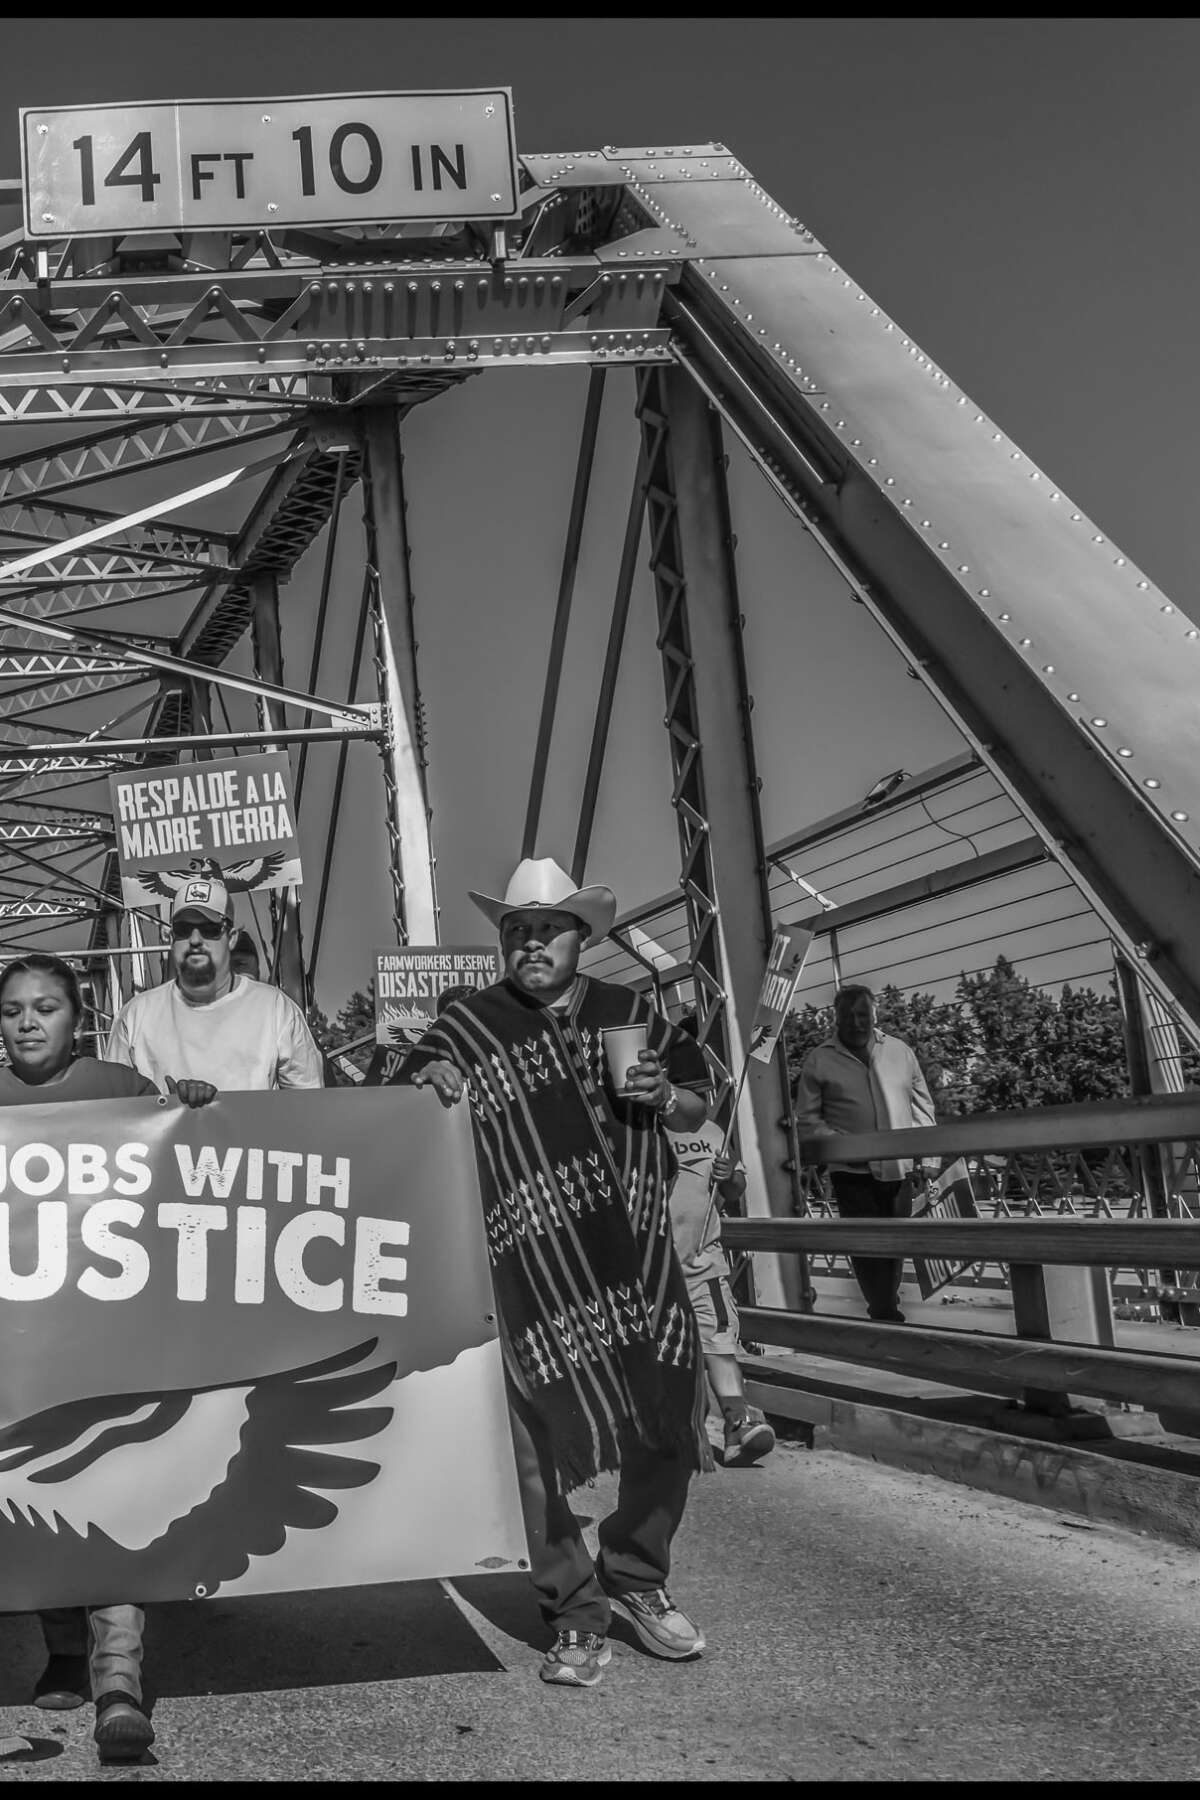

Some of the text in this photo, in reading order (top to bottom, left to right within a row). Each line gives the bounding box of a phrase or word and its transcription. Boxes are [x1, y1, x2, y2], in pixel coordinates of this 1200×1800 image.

[72, 121, 468, 206] 14 FT 10 IN
[117, 769, 288, 822] RESPALDE A LA
[120, 803, 294, 860] MADRE TIERRA
[377, 955, 496, 971] FARMWORKERS DESERVE
[378, 971, 461, 998] DISASTER
[674, 1139, 713, 1155] bok
[174, 1143, 351, 1209] WITH
